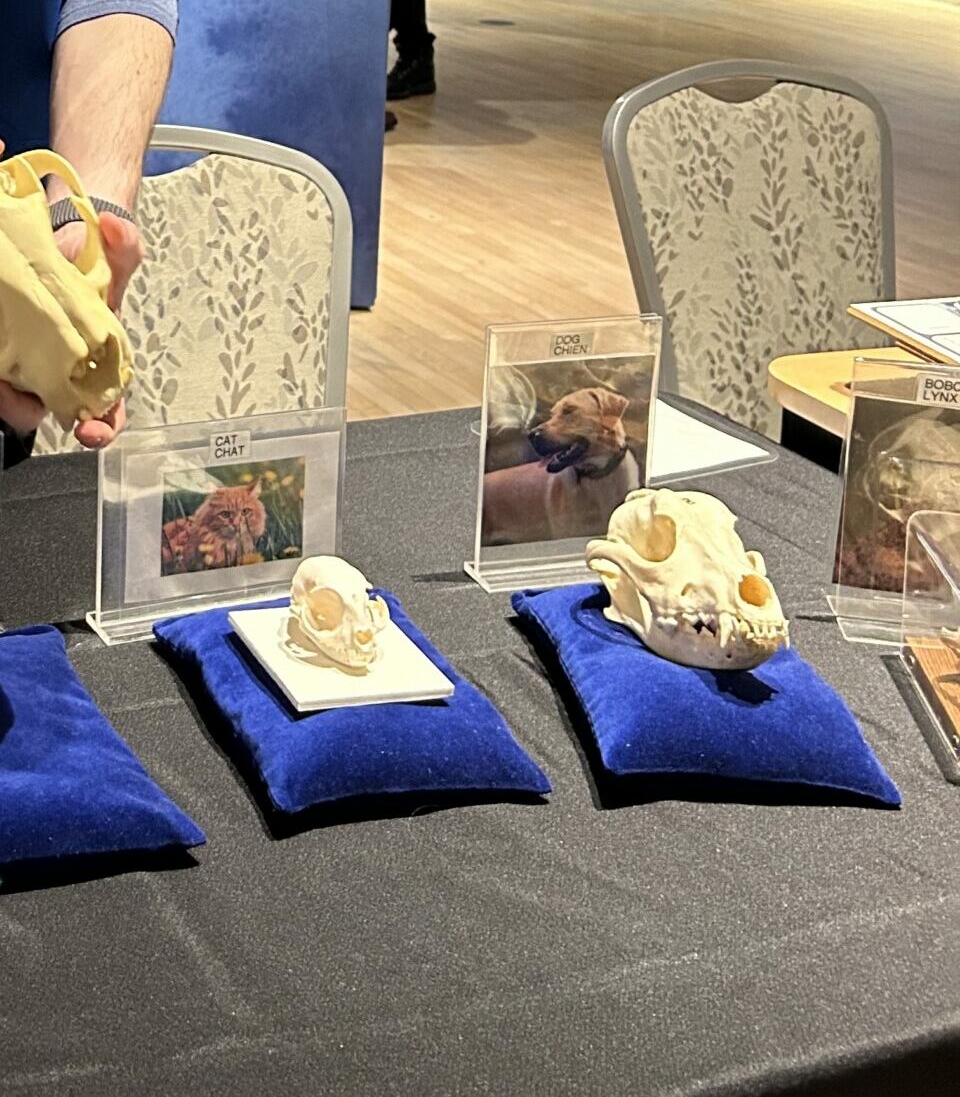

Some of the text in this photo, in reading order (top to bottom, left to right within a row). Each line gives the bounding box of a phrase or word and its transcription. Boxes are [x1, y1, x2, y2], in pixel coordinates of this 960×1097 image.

[556, 334, 581, 345] DOG
[554, 345, 588, 356] CHIEN
[923, 391, 959, 404] LYNX
[215, 434, 238, 447] CAT
[214, 445, 245, 459] CHAT
